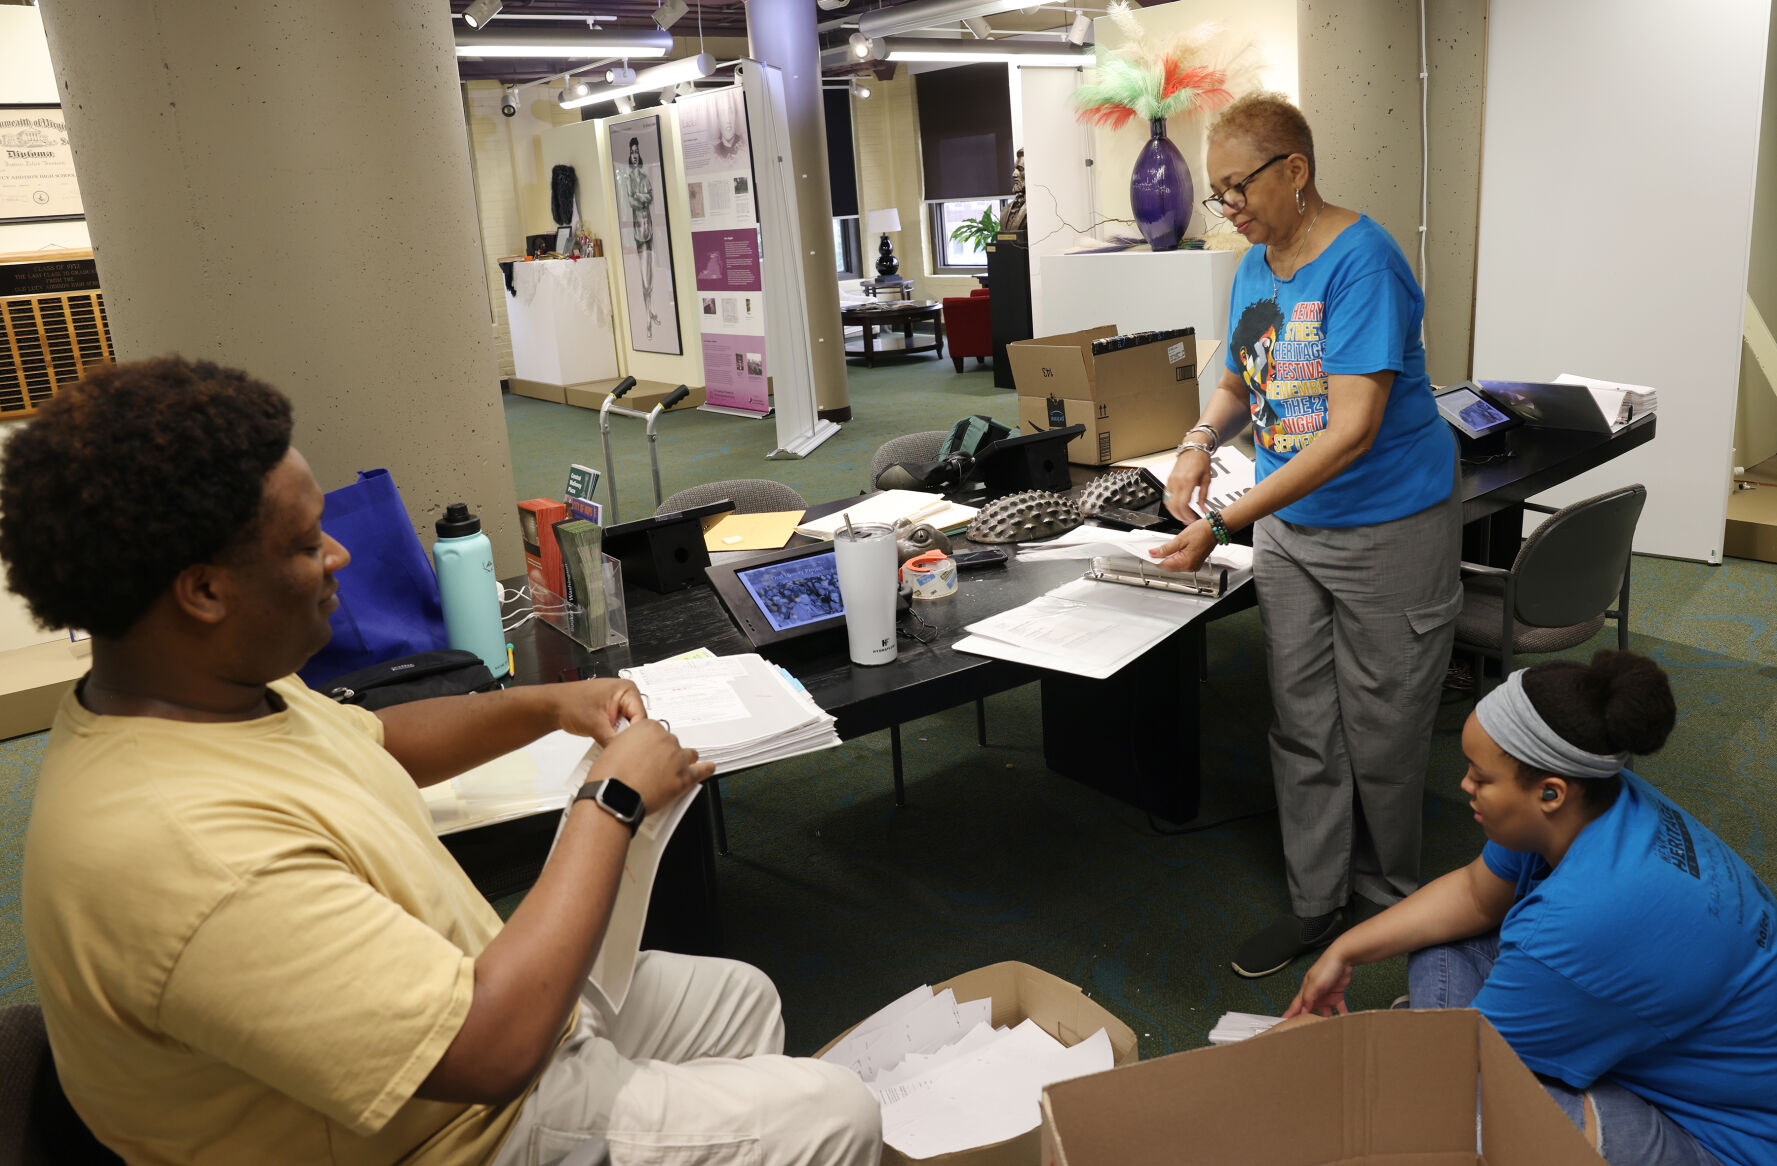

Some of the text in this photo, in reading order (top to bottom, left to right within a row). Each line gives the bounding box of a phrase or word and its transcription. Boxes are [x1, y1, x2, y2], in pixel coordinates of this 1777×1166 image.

[6, 150, 55, 159] Diploma
[1291, 301, 1325, 321] HENRY
[1285, 321, 1325, 342] STREET
[1276, 360, 1328, 380] FESTIVA
[1266, 378, 1328, 400] REMEMBE
[1281, 398, 1312, 417] THE
[1281, 412, 1325, 435] NIGHT
